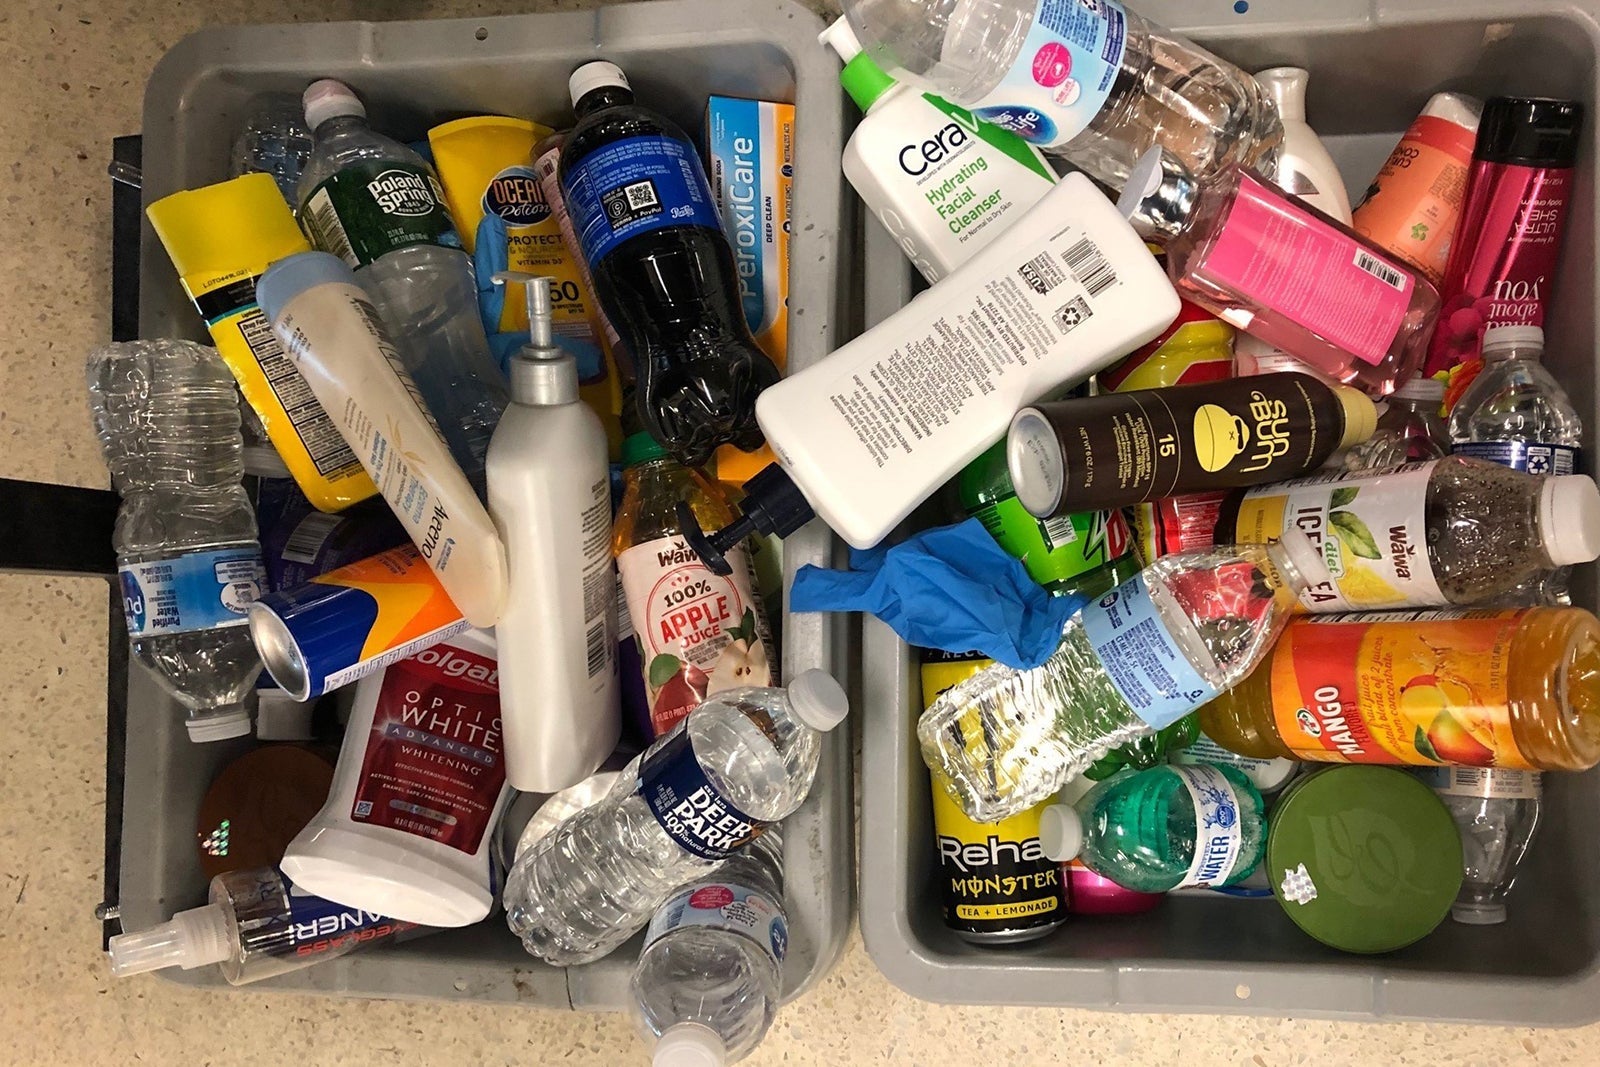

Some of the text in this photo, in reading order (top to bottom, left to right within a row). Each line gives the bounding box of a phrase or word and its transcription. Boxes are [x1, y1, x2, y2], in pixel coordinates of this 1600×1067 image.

[899, 112, 988, 176] CeraV
[915, 168, 938, 186] DEVELOPED
[936, 161, 946, 170] WITH
[925, 157, 988, 205] Hydrating
[367, 174, 426, 200] Poland
[377, 188, 435, 214] Spring
[498, 203, 551, 217] Potion
[640, 207, 661, 217] PayPal
[936, 186, 977, 220] Facial
[949, 189, 1003, 234] Cleanser
[729, 136, 757, 298] PeroxiCare
[764, 196, 773, 243] DEEP CLEAN
[958, 199, 1013, 243] For Normal to Dry Skin
[1522, 209, 1557, 220] SHEA
[508, 234, 563, 245] PROTECT
[1516, 222, 1556, 234] ULTRA
[1020, 262, 1042, 287] USA
[1037, 253, 1057, 277] MATERIALS
[1495, 276, 1544, 300] you
[1489, 302, 1536, 317] about
[973, 295, 1027, 365] DISTRIBUTED BY: Walmart Inc.,
[986, 301, 1025, 350] Bentonville, AR 72716
[829, 394, 846, 415] moisture
[836, 393, 849, 407] great
[846, 404, 856, 415] you
[868, 367, 923, 440] WARNING: For external use only.
[874, 360, 932, 437] INGREDIENTS: WATER, GLYCERIN,
[853, 413, 863, 425] give
[860, 423, 871, 435] help
[855, 429, 867, 444] offers
[1078, 426, 1088, 440] NET
[1082, 440, 1090, 450] WT
[1158, 433, 1176, 457] 15
[864, 442, 877, 457] lotion
[872, 440, 889, 460] complex
[874, 456, 884, 467] This
[1085, 456, 1093, 466] OZ
[1085, 471, 1093, 482] 170
[402, 478, 420, 516] Therapy
[412, 485, 430, 525] Eczema
[425, 497, 452, 560] Aveeno
[1297, 506, 1323, 556] ICE
[657, 549, 699, 567] Waw
[1325, 541, 1340, 573] diet
[1388, 525, 1411, 580] Wawa
[664, 579, 712, 608] 100%
[1307, 579, 1337, 604] EA
[152, 616, 181, 629] Purified
[157, 607, 180, 616] Water
[659, 596, 730, 644] APPLE
[681, 625, 720, 648] JUICE
[1373, 636, 1384, 667] juices
[407, 648, 499, 684] olgat
[1370, 666, 1380, 674] 2
[1362, 674, 1375, 704] juice
[1370, 675, 1385, 689] of
[405, 690, 502, 730] OPTIC
[1373, 692, 1388, 721] blend
[1384, 652, 1413, 744] from concentrate
[1314, 686, 1365, 755] MANGO
[1342, 701, 1364, 744] FLAVORED
[392, 728, 492, 763] ADVANCED
[395, 763, 424, 775] EFFECTIVE
[401, 746, 481, 776] WHITENING
[370, 773, 397, 783] ACTIVELY
[398, 778, 422, 790] WHITENS
[456, 794, 468, 803] NEW
[382, 783, 405, 795] ENAMEL
[406, 788, 421, 798] SAFE
[424, 794, 451, 808] FRESHENS
[452, 802, 472, 814] BREATH
[703, 785, 715, 798] EST.
[662, 811, 690, 837] 100%
[672, 799, 739, 849] PARK
[688, 787, 752, 838] DEER
[678, 833, 705, 851] natural
[939, 836, 1048, 873] Reha
[1199, 835, 1230, 883] WATER
[951, 868, 1058, 898] MONSTER
[961, 907, 979, 917] TEA
[996, 900, 1054, 916] LEMONADE
